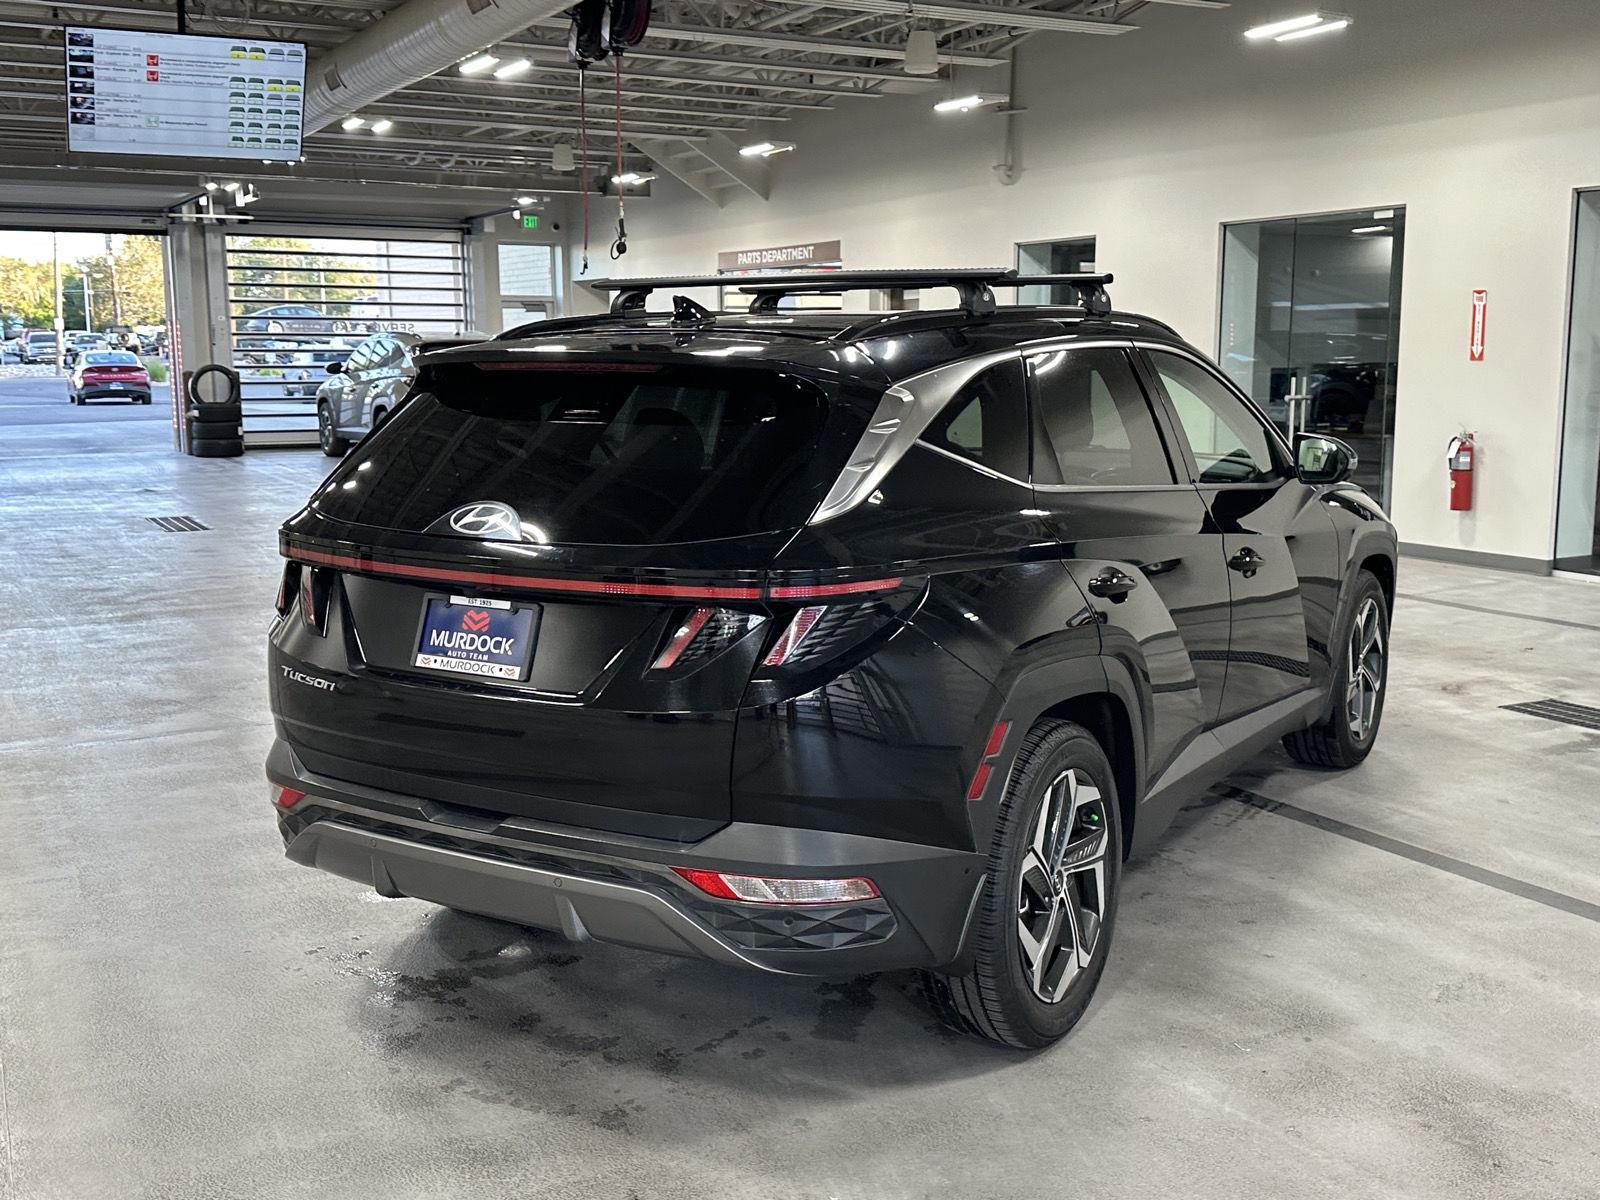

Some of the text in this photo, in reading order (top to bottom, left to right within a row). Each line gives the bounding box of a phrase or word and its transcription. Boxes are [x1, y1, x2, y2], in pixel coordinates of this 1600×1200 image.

[737, 246, 814, 264] PARTS DEPARTMENT
[430, 629, 514, 655] MURDOCK
[447, 650, 489, 661] AUTO TEAM
[439, 659, 496, 674] MURDOCK
